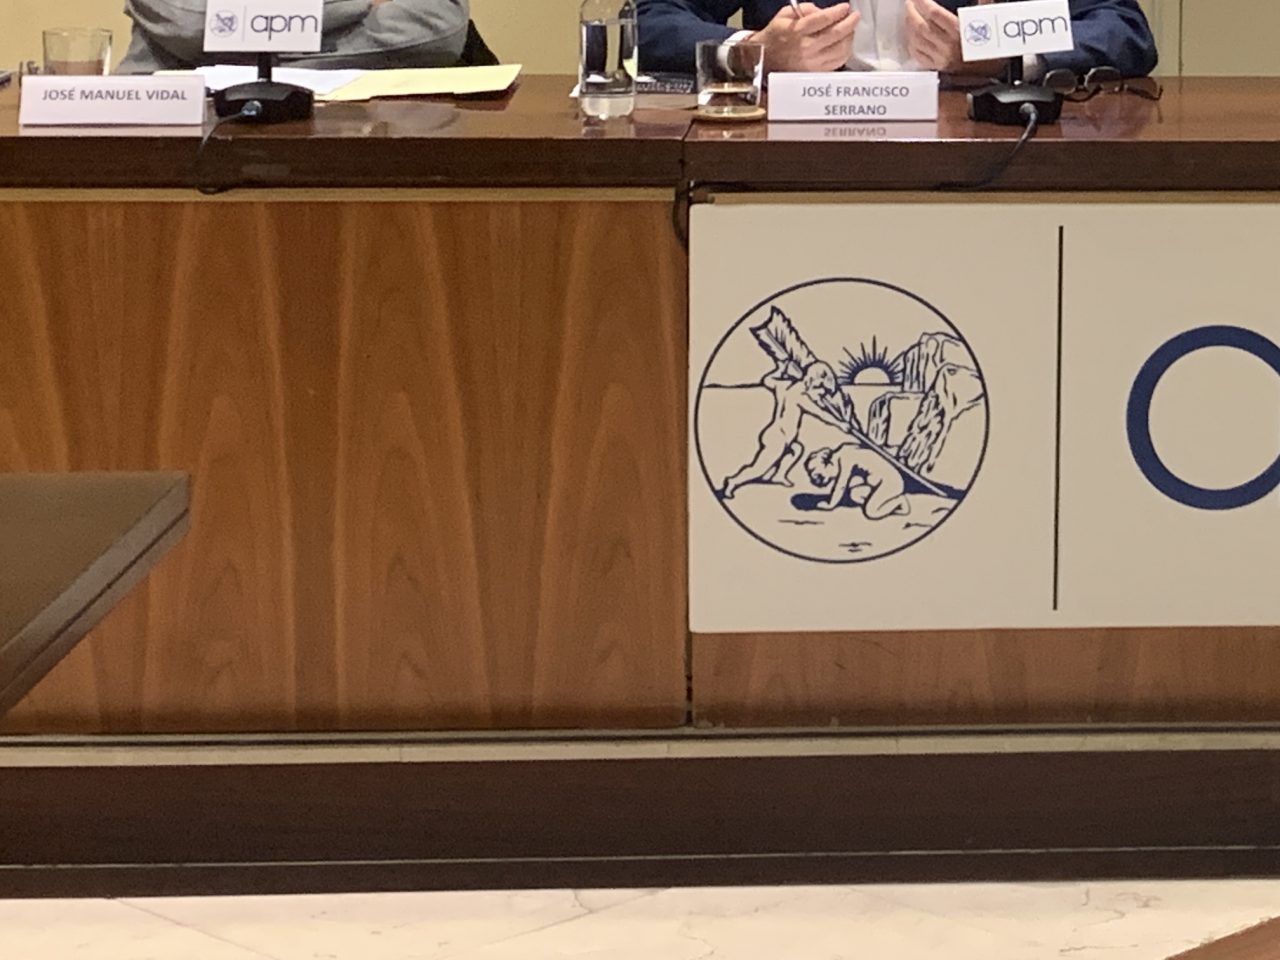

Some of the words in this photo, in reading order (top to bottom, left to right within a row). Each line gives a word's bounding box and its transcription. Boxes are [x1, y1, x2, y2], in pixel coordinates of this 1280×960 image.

[251, 13, 318, 41] apm
[1003, 15, 1069, 44] apm
[42, 86, 76, 101] JOSÉ
[79, 89, 142, 101] MANUEL
[146, 89, 188, 100] VIDAL
[801, 82, 832, 98] JOSÉ
[836, 86, 910, 98] FRANCISCO
[823, 104, 888, 116] SERRANO
